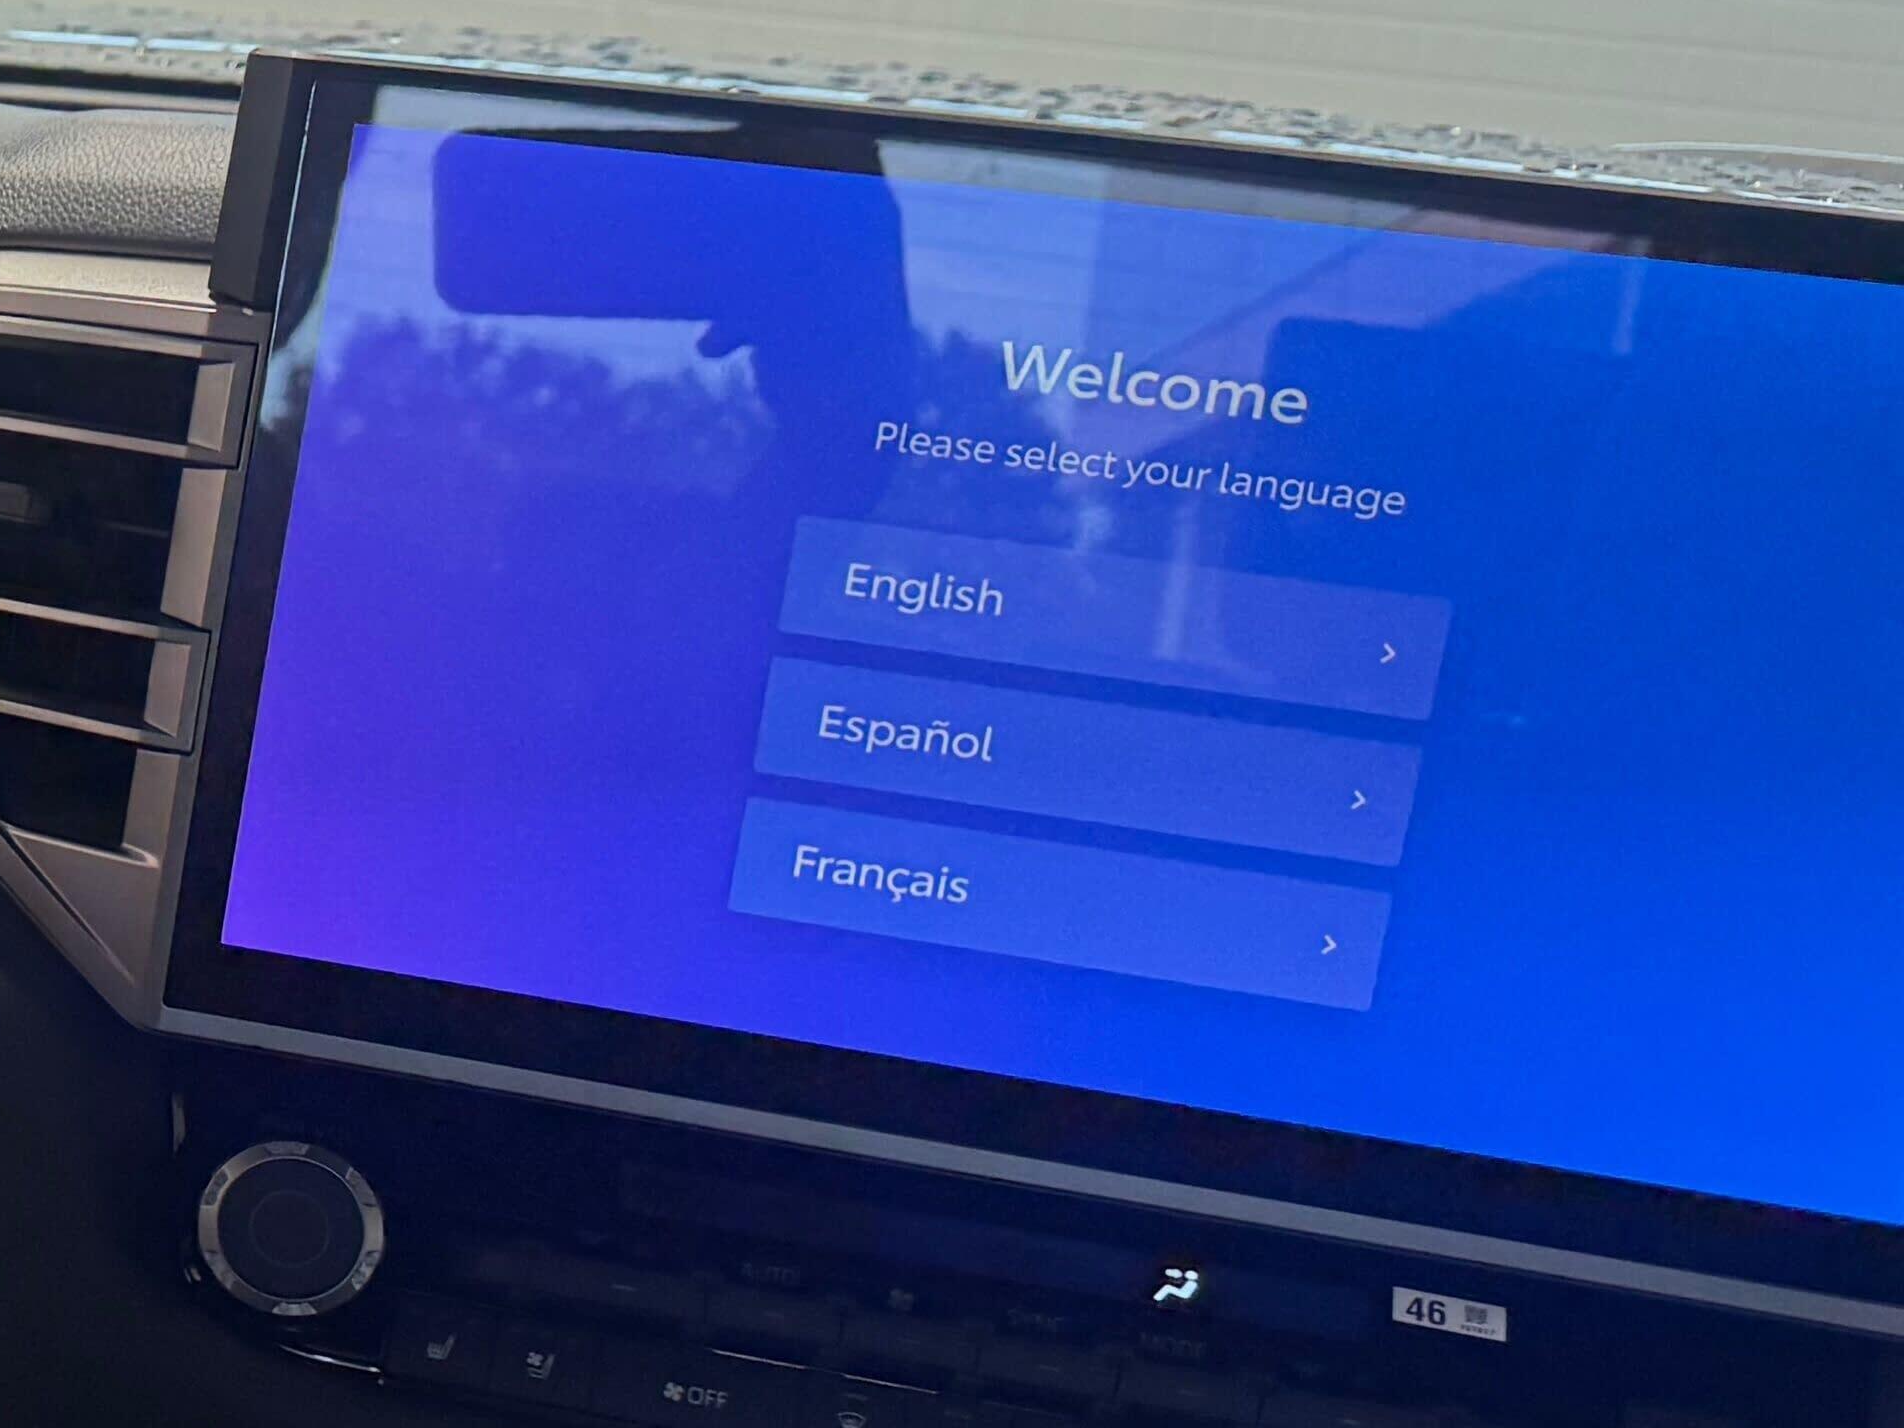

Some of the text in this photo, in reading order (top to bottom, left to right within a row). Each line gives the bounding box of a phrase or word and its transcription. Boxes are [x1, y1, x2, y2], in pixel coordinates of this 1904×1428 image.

[1001, 340, 1310, 425] Welcome
[874, 420, 1407, 521] Please select your language
[843, 562, 1005, 617] English
[816, 705, 995, 765] Español
[791, 844, 971, 906] Français
[1405, 1296, 1447, 1326] 46
[687, 1385, 729, 1410] OFF
